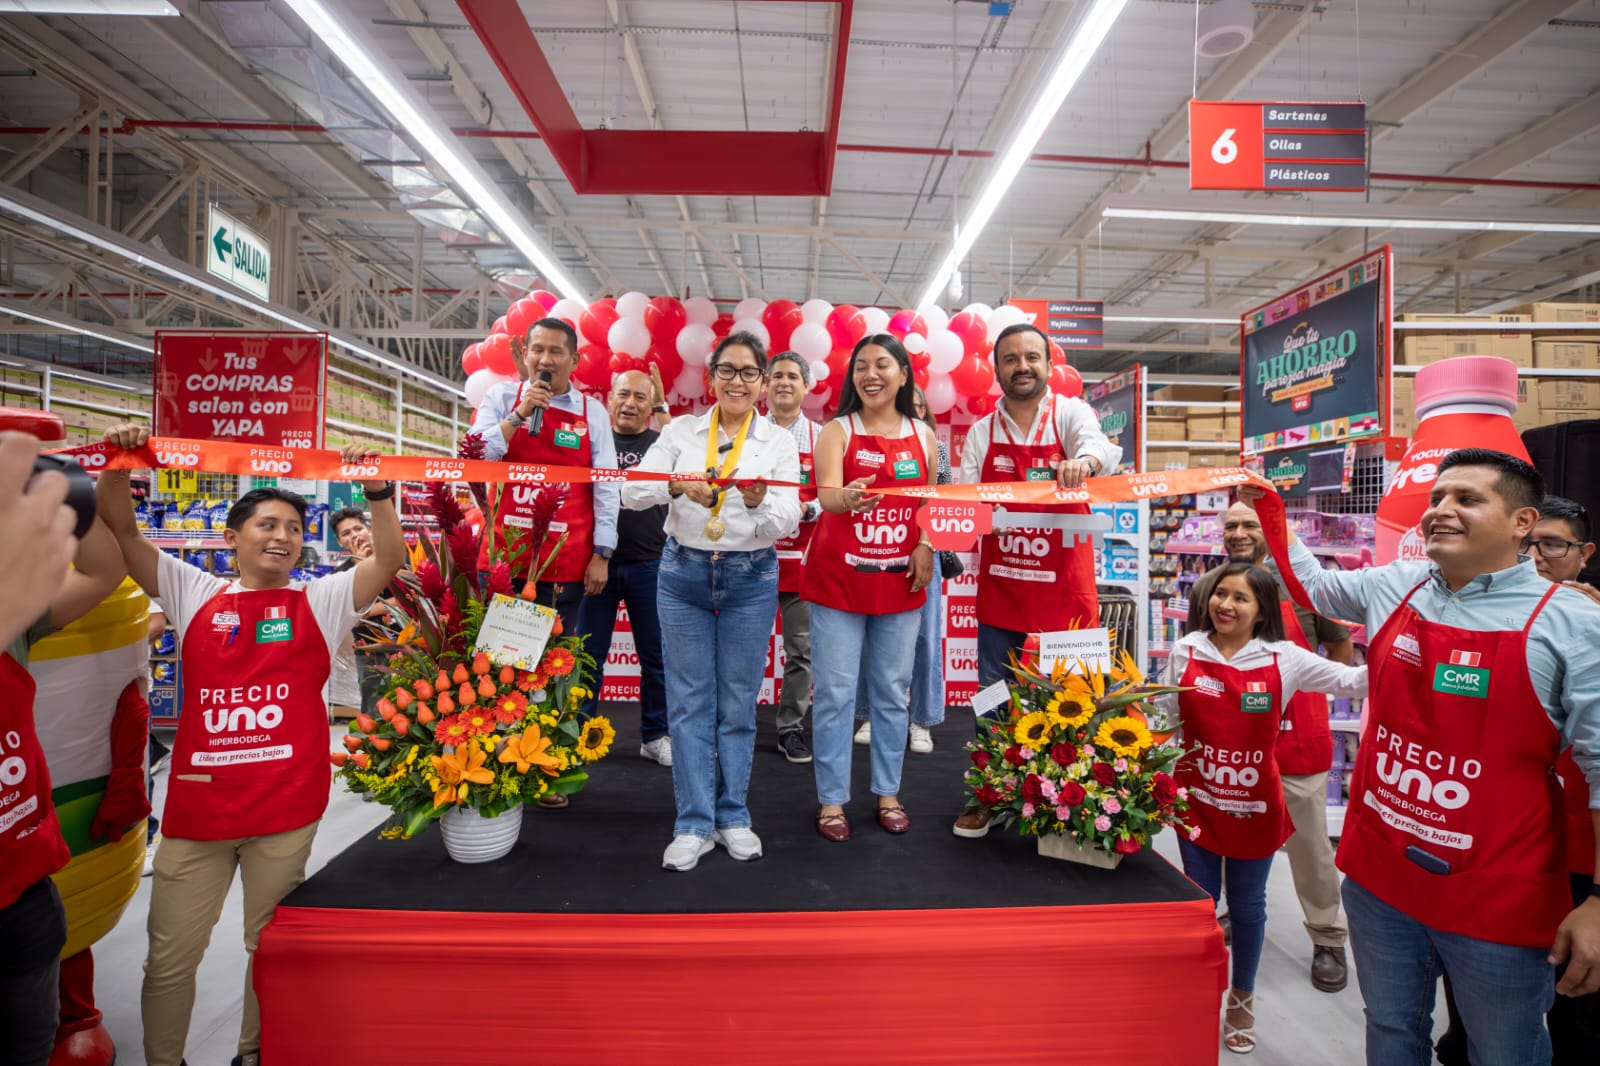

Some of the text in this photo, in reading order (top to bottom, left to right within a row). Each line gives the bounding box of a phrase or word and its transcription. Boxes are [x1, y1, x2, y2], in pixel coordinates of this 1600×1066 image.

[1268, 109, 1328, 121] Sartenes
[1210, 128, 1238, 165] 6
[1268, 139, 1302, 151] Ollas
[1268, 168, 1330, 181] Plásticos
[234, 236, 267, 285] SALIDA
[1283, 327, 1320, 354] Que tu
[224, 352, 258, 370] Tus
[1256, 329, 1357, 385] AHORRO
[1306, 356, 1348, 379] magia
[186, 374, 294, 393] COMPRAS
[187, 396, 289, 415] salen con
[212, 419, 265, 437] YAPA
[281, 430, 313, 438] PRECIO
[155, 440, 201, 452] PRECIO
[282, 438, 312, 449] uno
[73, 453, 107, 467] no
[156, 451, 199, 466] uno
[250, 448, 294, 460] PRECIO
[1410, 447, 1452, 463] YOGUR
[251, 459, 293, 473] uno
[341, 466, 379, 477] uno
[425, 460, 465, 469] PRECIO
[508, 464, 548, 473] PRECIO
[425, 469, 463, 479] uno
[508, 472, 546, 480] uno
[1030, 471, 1051, 480] CMR
[1128, 474, 1167, 484] PRECIO
[976, 484, 1013, 492] PRECIO
[1131, 482, 1169, 497] uno
[1054, 491, 1090, 501] uno
[1208, 497, 1215, 508] 4
[929, 506, 976, 517] PRECIO
[930, 518, 975, 533] uno
[853, 522, 908, 545] uno
[998, 534, 1050, 558] uno
[1402, 545, 1424, 557] PUL
[950, 605, 977, 614] PREC
[262, 622, 289, 634] CMR
[1046, 641, 1091, 650] BIENVENIDO
[1443, 669, 1480, 687] CMR
[200, 683, 290, 705] PRECIO
[603, 685, 641, 695] PRECIO
[1246, 696, 1269, 706] CMR
[202, 704, 284, 734] uno
[208, 734, 272, 747] HIPERBODEGA
[217, 755, 228, 763] en
[229, 751, 261, 763] precios
[262, 748, 285, 759] bajos
[1376, 724, 1482, 779] PRECIO
[1196, 757, 1259, 787] uno
[1376, 751, 1470, 810] uno
[1377, 786, 1447, 823] HIPERBODEGA
[1382, 810, 1463, 845] en precios bajos
